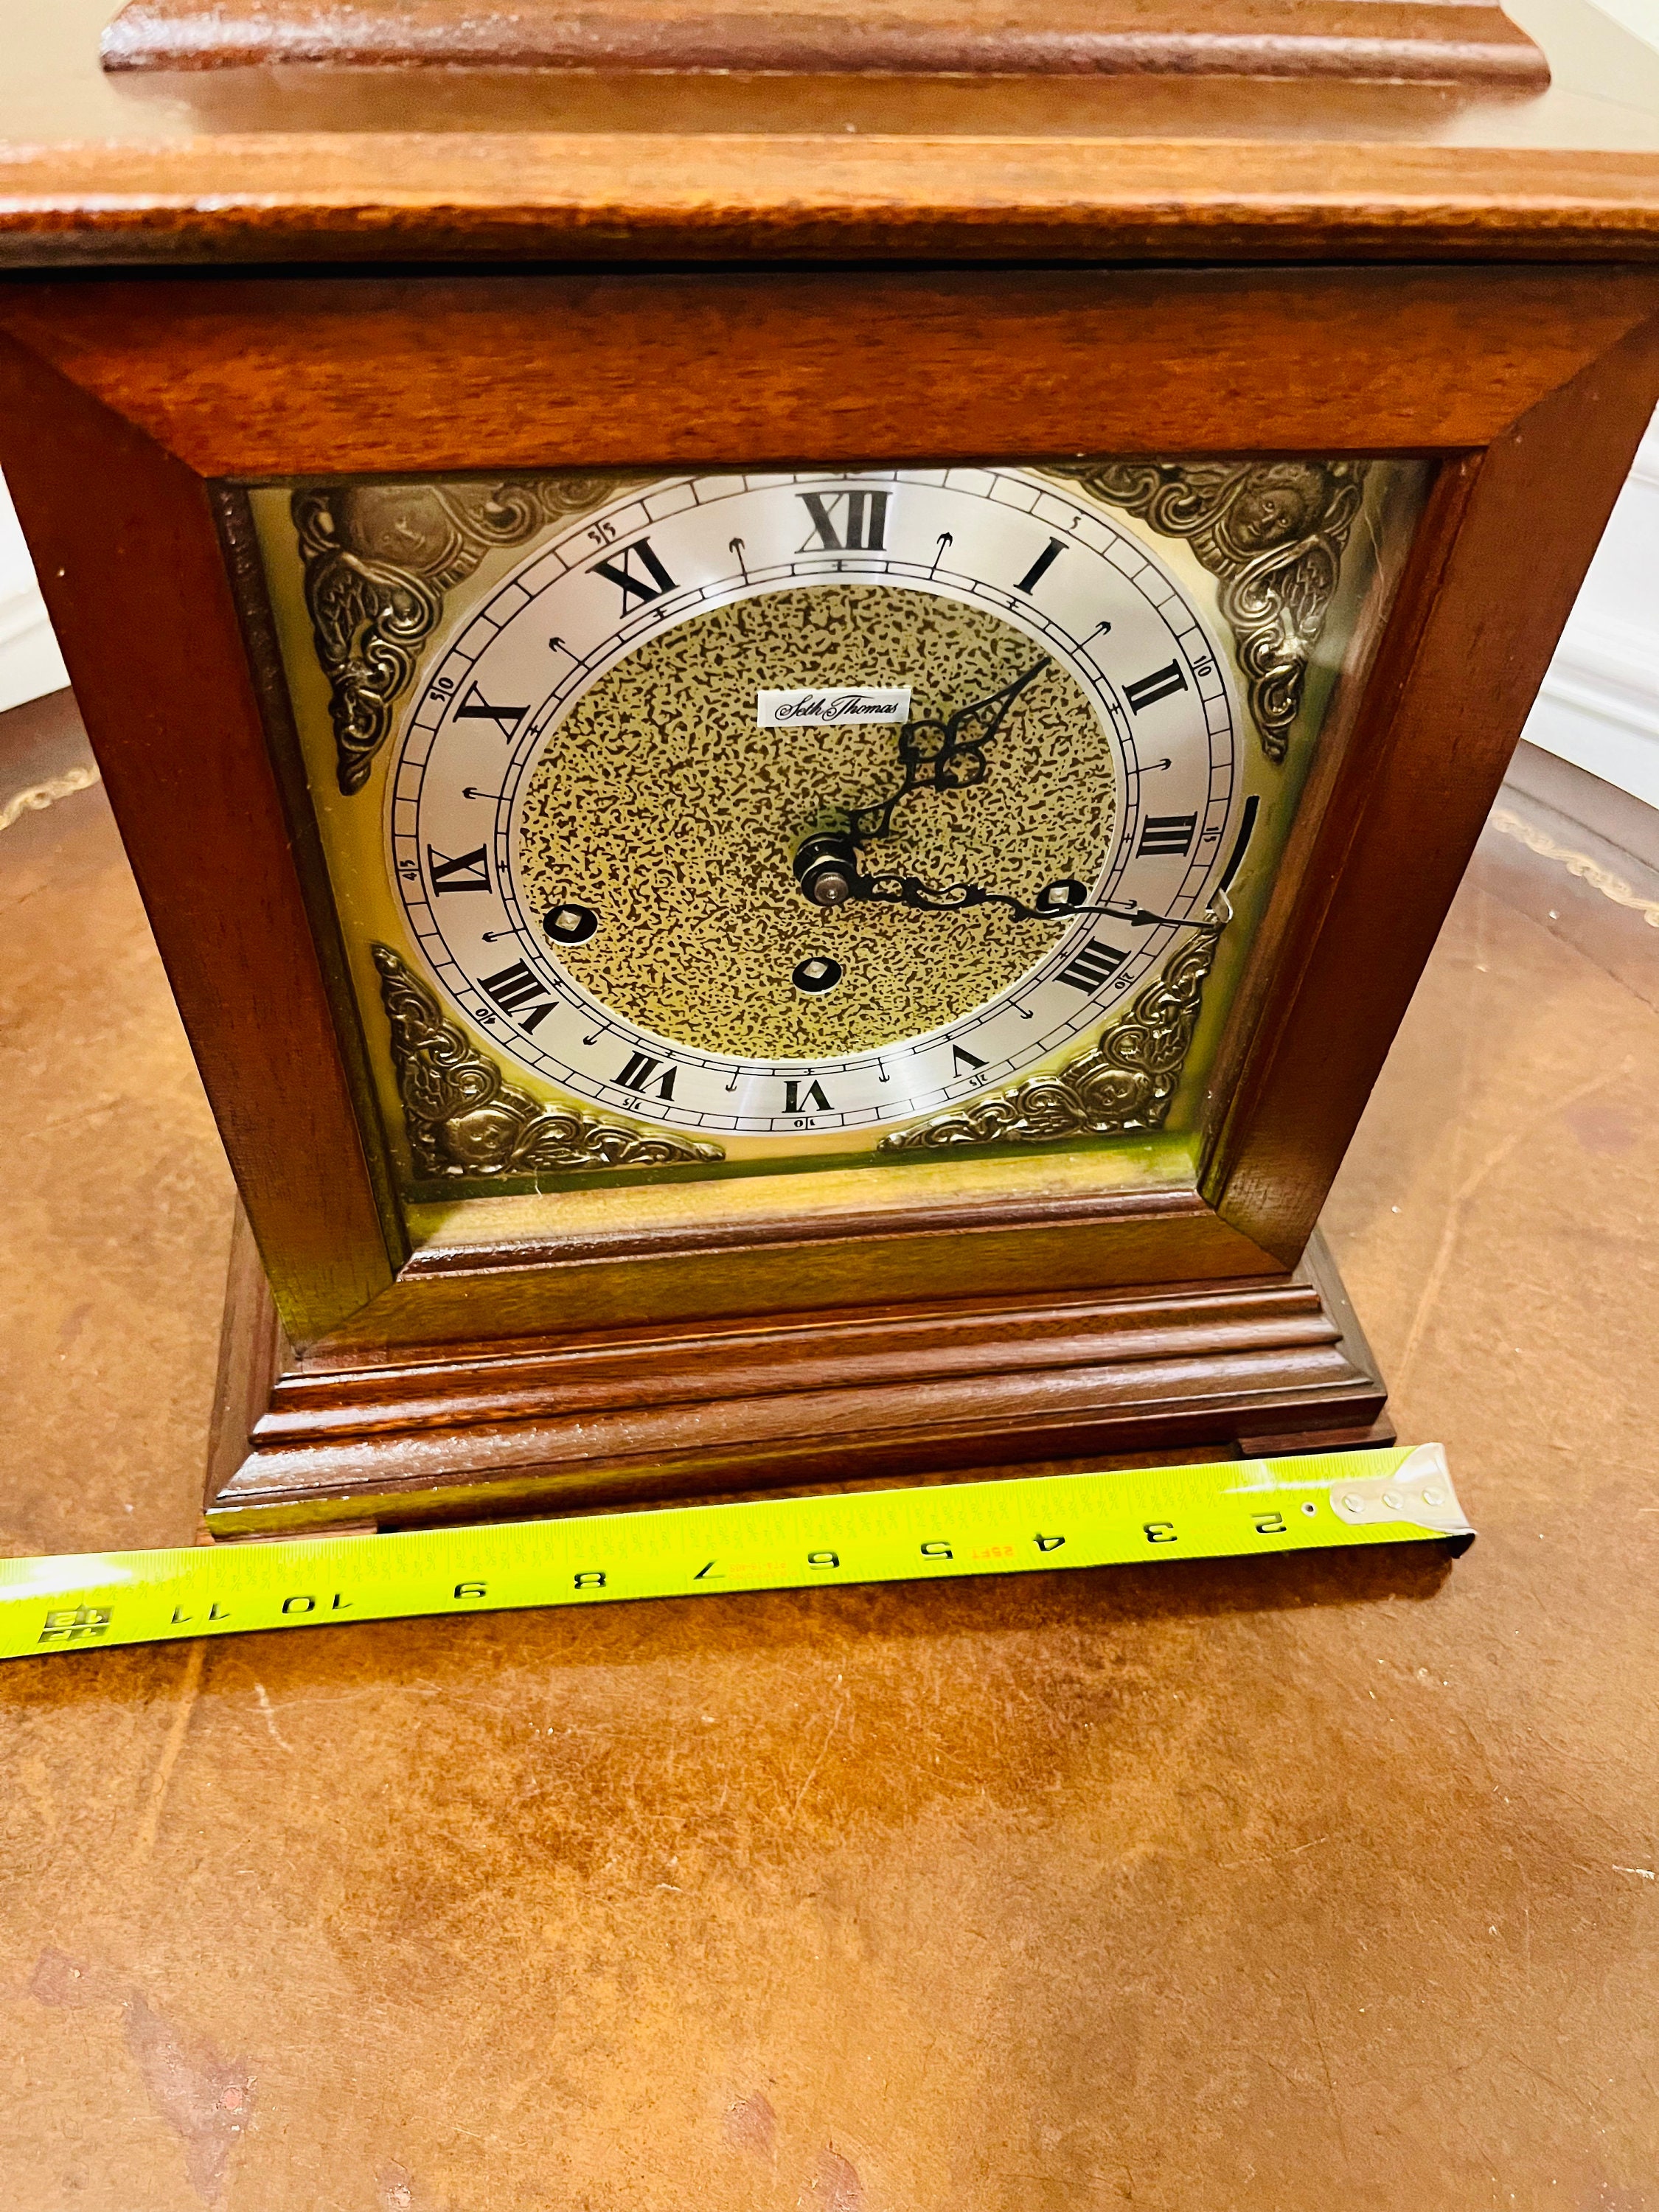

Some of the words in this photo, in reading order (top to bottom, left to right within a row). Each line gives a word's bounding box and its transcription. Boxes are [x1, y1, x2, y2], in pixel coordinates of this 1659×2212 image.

[588, 522, 617, 544] 55
[795, 490, 893, 554] XII
[1069, 515, 1082, 529] 5
[1013, 537, 1069, 595] I
[585, 537, 681, 619] XI
[1194, 654, 1212, 677] 10
[430, 676, 453, 702] 50
[1121, 658, 1189, 716] II
[453, 681, 531, 745] X
[775, 694, 825, 720] Seth
[822, 695, 899, 721] Thomas
[1135, 810, 1198, 860] III
[1205, 825, 1221, 842] 15
[400, 859, 415, 882] 45
[427, 843, 493, 897] IX
[1052, 936, 1132, 997] IIII
[1114, 971, 1134, 990] 20
[476, 958, 560, 1036] VIII
[952, 1044, 990, 1079] V
[609, 1050, 679, 1102] VII
[969, 1073, 989, 1088] 25
[781, 1079, 835, 1114] VI
[1143, 1521, 1178, 1543] 3
[1250, 1512, 1287, 1534] 2
[919, 1540, 953, 1562] 5
[973, 1546, 1014, 1559] 25FT
[1033, 1531, 1066, 1552] 4
[694, 1559, 726, 1579] 7
[807, 1551, 839, 1571] 6
[453, 1582, 488, 1599] 9
[574, 1571, 606, 1590] 8
[171, 1600, 231, 1624] 11
[282, 1591, 354, 1614] 10
[53, 1609, 105, 1626] 12
